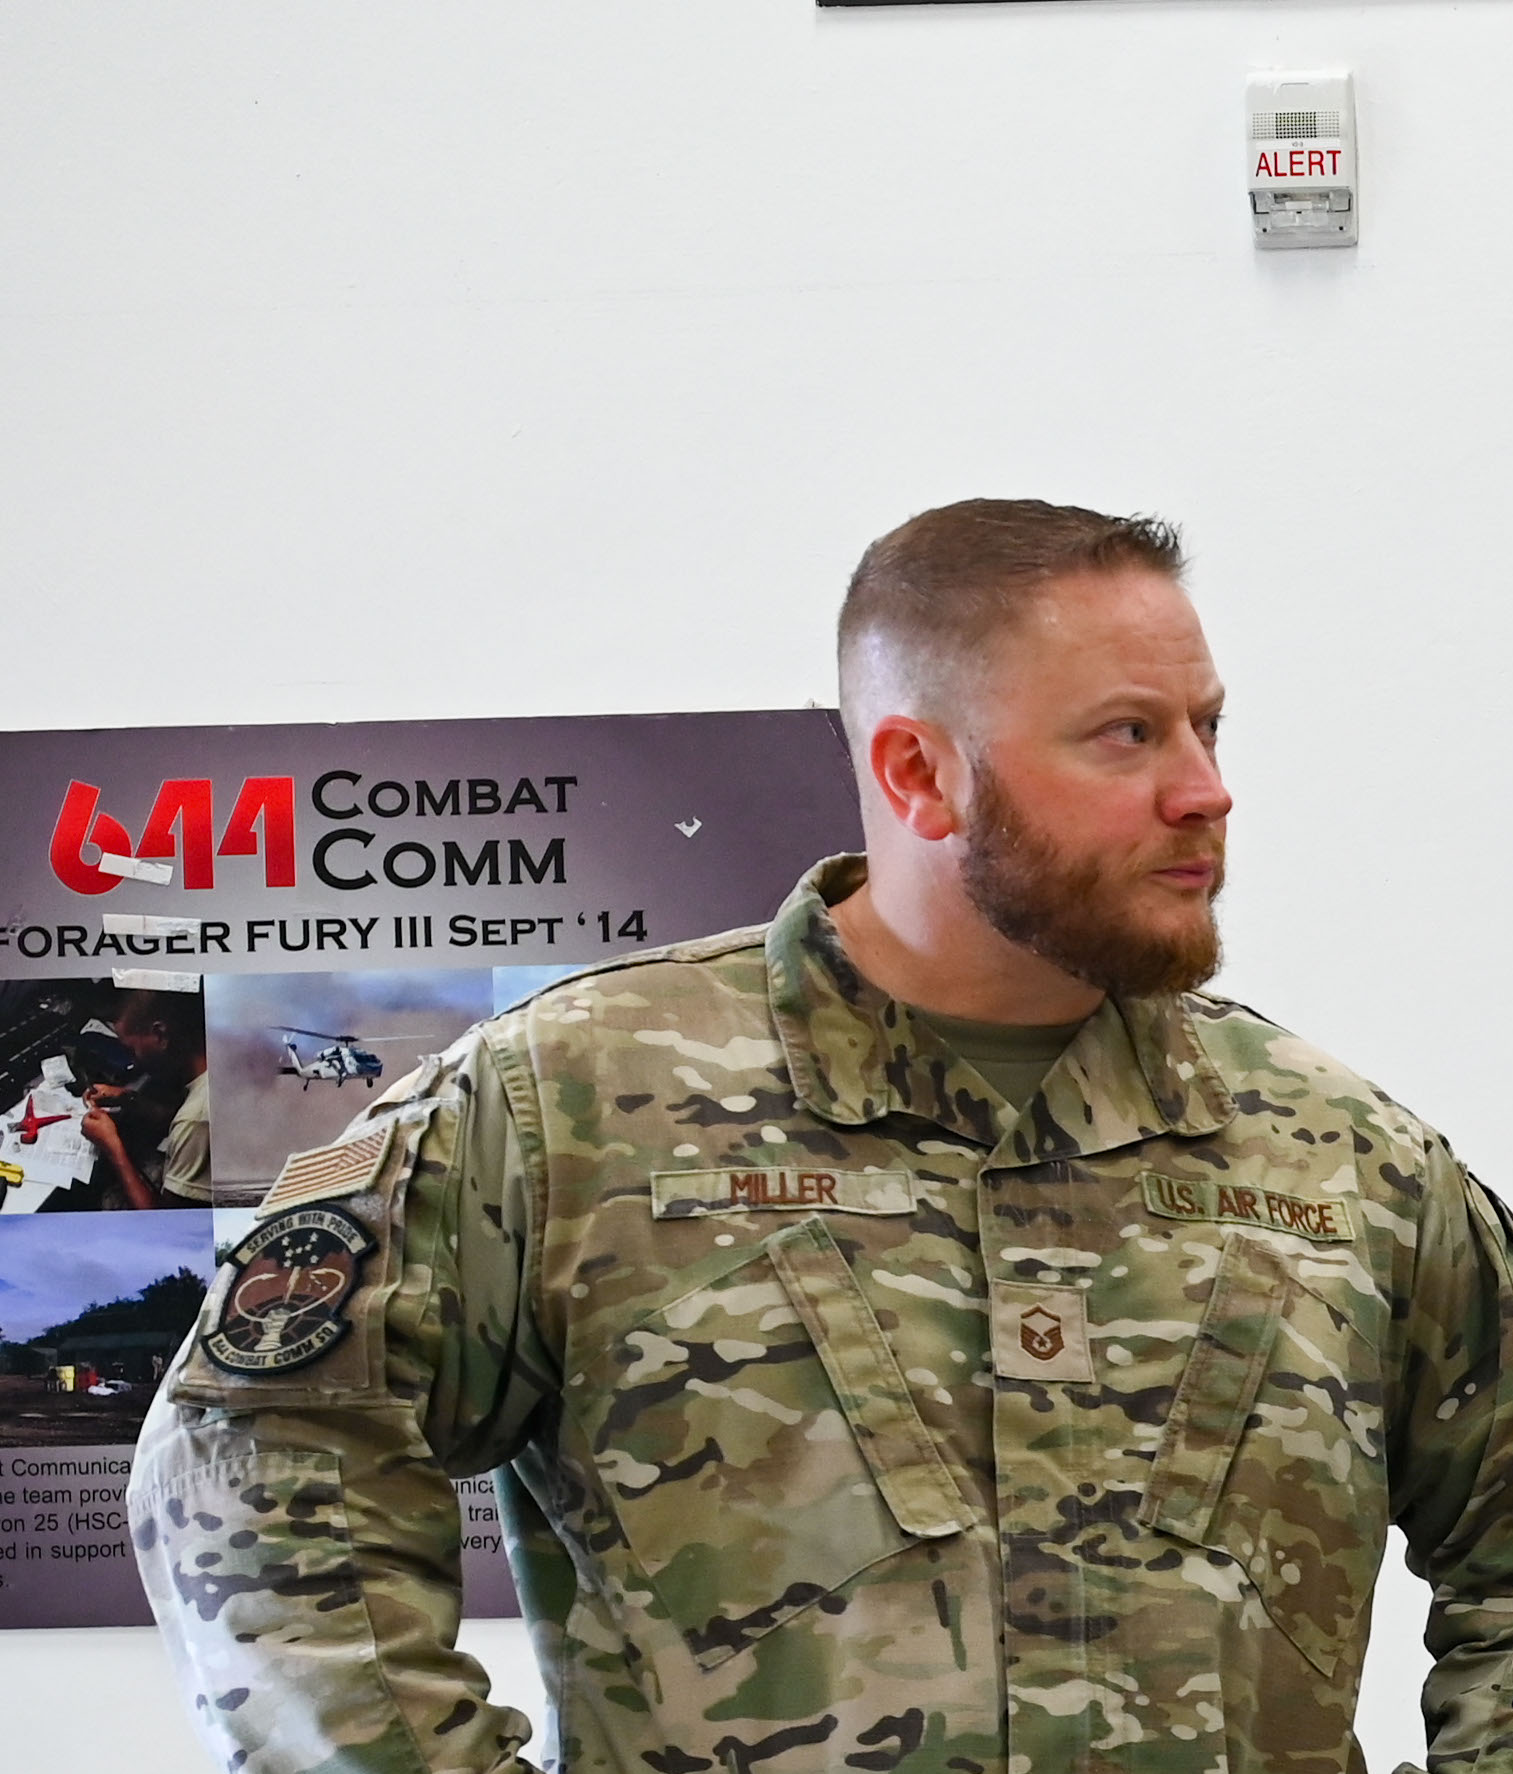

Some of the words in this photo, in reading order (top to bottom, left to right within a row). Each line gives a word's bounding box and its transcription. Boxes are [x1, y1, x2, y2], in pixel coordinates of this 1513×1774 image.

[1255, 150, 1342, 177] ALERT
[48, 775, 296, 896] 644
[246, 915, 380, 953] FURY
[393, 914, 433, 949] III
[448, 915, 564, 949] SEPT
[729, 1172, 838, 1206] MILLER
[1155, 1178, 1200, 1215] U.S.
[1217, 1187, 1258, 1218] AIR
[1267, 1196, 1334, 1234] FORCE
[247, 1217, 294, 1254] SERVING
[327, 1216, 359, 1244] PRIDE
[273, 1339, 315, 1365] COMM
[23, 1487, 72, 1504] team
[34, 1512, 58, 1532] 25
[68, 1512, 128, 1535] (HSC-
[26, 1541, 42, 1560] in
[51, 1540, 126, 1563] support
